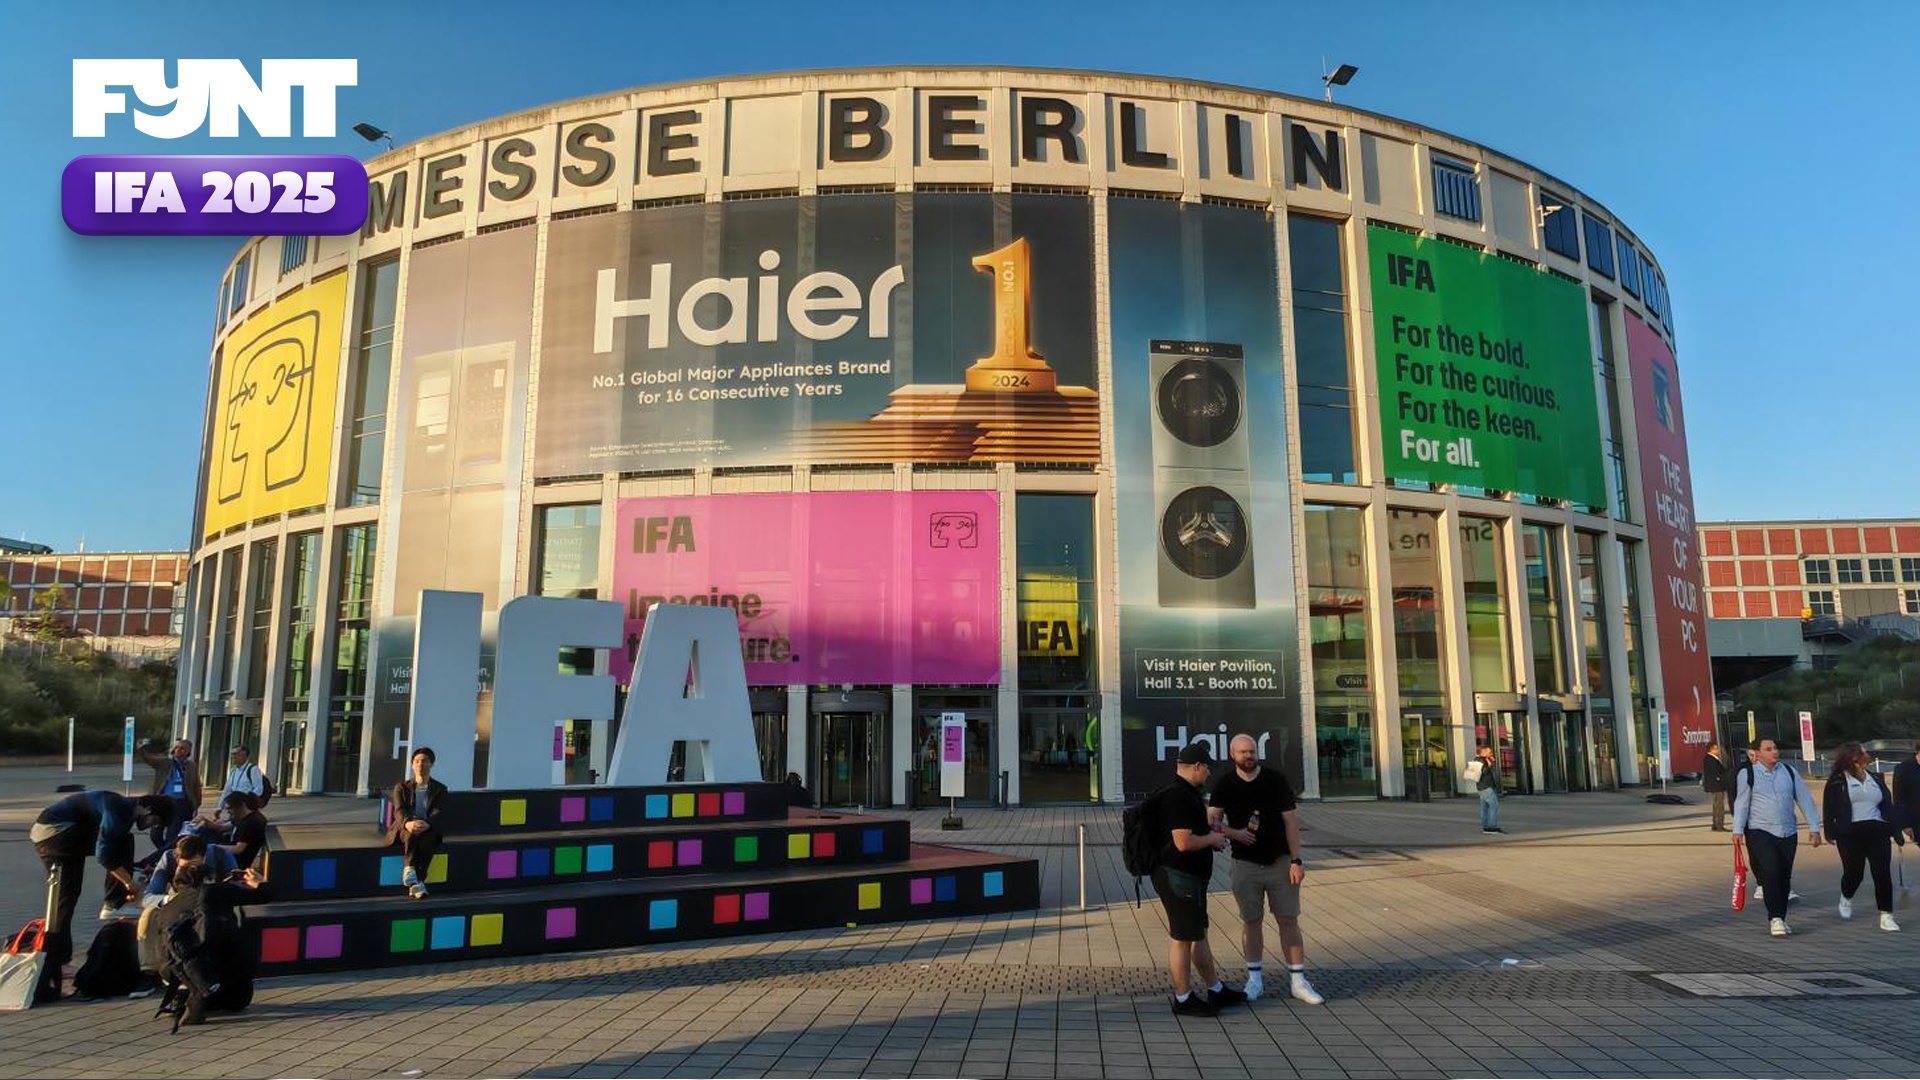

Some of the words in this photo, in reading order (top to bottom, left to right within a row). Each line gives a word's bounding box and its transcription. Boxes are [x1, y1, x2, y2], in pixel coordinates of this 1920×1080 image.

[363, 109, 700, 240] MESSE
[829, 95, 1342, 190] BERLIN
[1002, 261, 1014, 292] NO.1
[1387, 253, 1436, 293] IFA
[593, 249, 904, 354] Haier
[1392, 315, 1431, 349] For
[1436, 324, 1474, 357] the
[1479, 332, 1530, 370] bold.
[592, 373, 625, 388] No.1
[631, 369, 682, 386] Global
[687, 365, 735, 383] Major
[739, 362, 833, 381] Appliances
[838, 360, 891, 375] Brand
[992, 374, 1031, 388] 2024
[1395, 353, 1434, 386] For
[1440, 362, 1477, 393] the
[1482, 373, 1561, 411] curious.
[638, 390, 661, 405] for
[666, 390, 683, 403] 16
[689, 384, 789, 401] Consecutive
[795, 383, 843, 397] Years
[1398, 391, 1437, 424] For
[1443, 399, 1480, 431] the
[1485, 404, 1541, 441] keen.
[1400, 429, 1440, 463] For
[1446, 437, 1480, 468] all.
[1659, 453, 1683, 495] THE
[1656, 490, 1691, 535] HEART
[633, 516, 696, 553] IFA
[1673, 537, 1688, 571] OF
[1668, 574, 1699, 614] YOUR
[1017, 621, 1074, 651] IFA
[1681, 618, 1698, 653] PC
[1144, 658, 1175, 672] Visit
[1179, 658, 1216, 672] Haier
[1220, 659, 1276, 675] Pavilion,
[1145, 677, 1171, 689] Hall
[1176, 677, 1194, 689] 3.1
[1209, 677, 1247, 690] Booth
[1252, 678, 1277, 690] 101.
[391, 683, 410, 694] Hall
[407, 589, 764, 791] IFA
[1156, 723, 1270, 761] Hair
